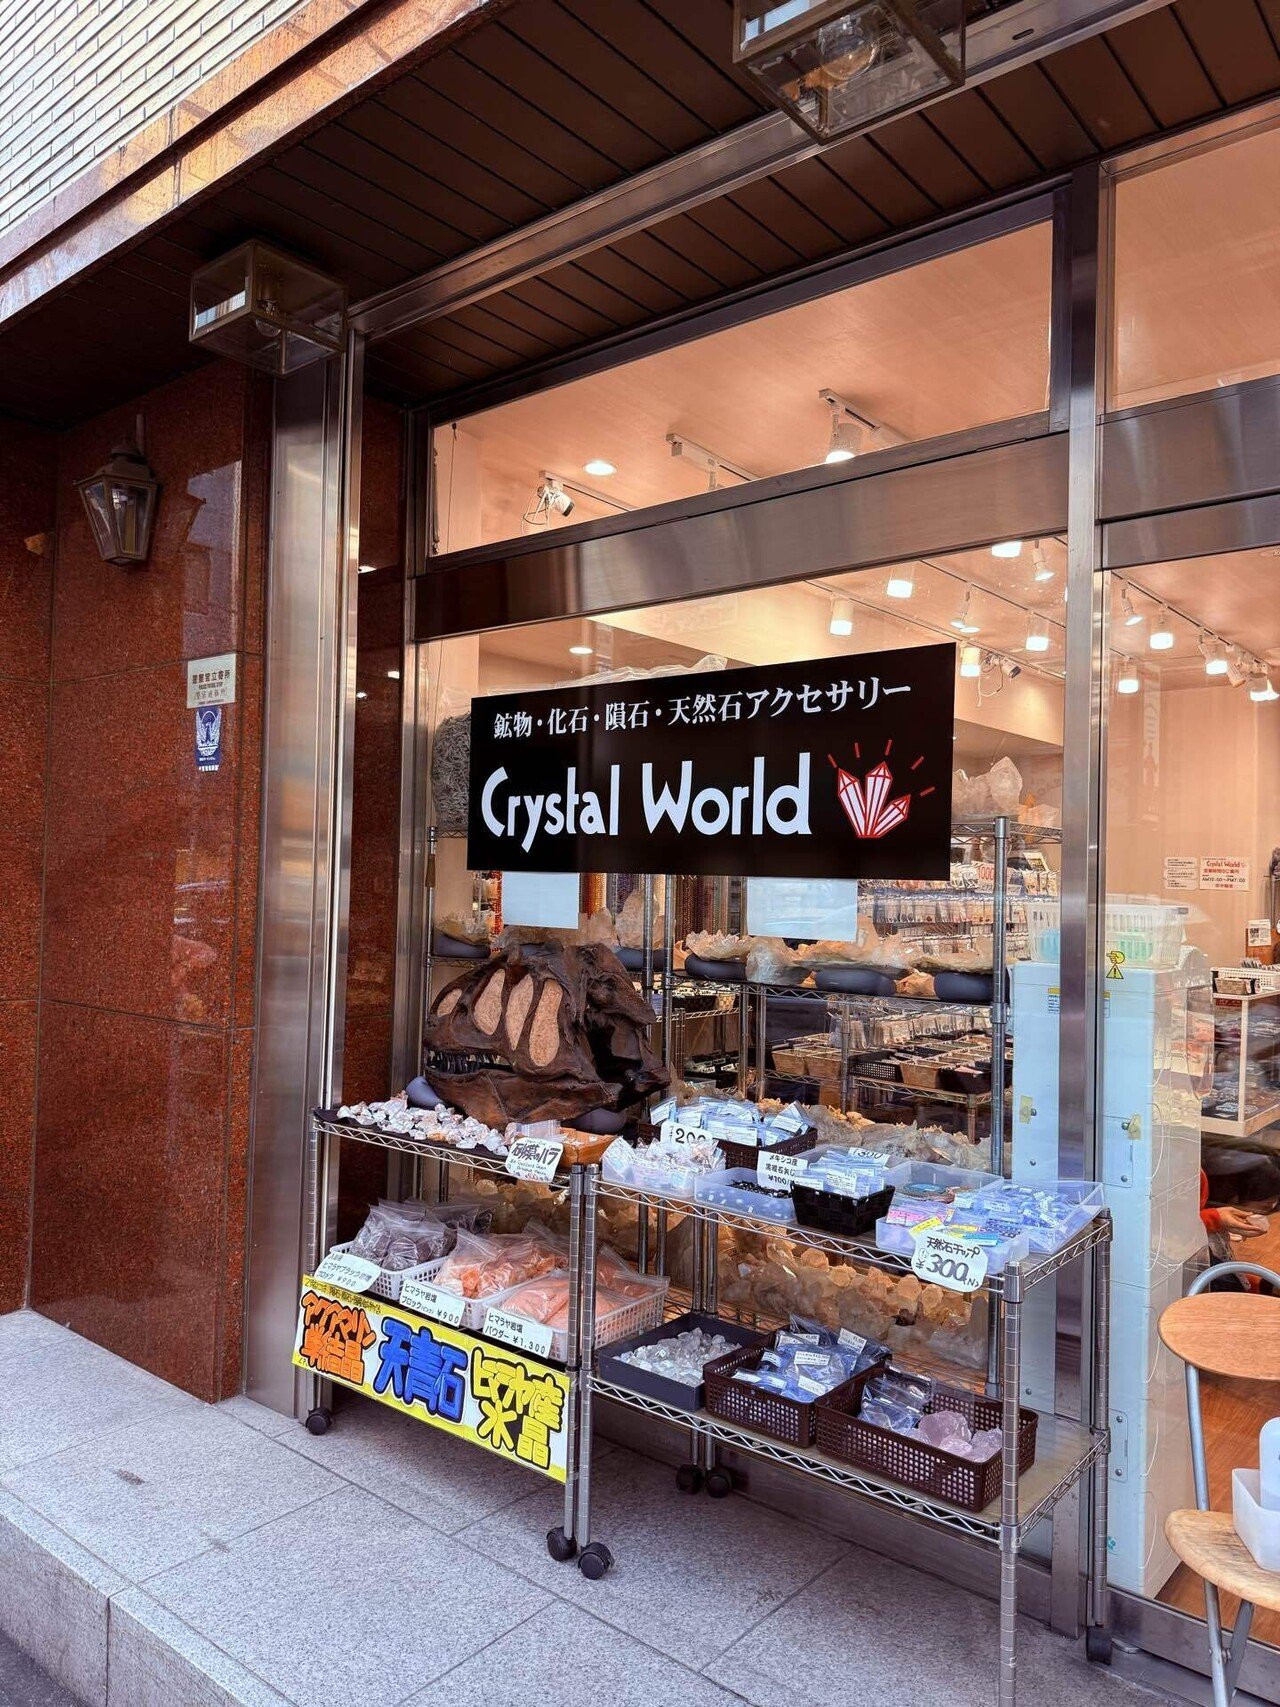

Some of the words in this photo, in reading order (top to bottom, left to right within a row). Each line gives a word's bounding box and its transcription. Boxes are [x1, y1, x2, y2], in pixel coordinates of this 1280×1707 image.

[493, 676, 912, 739] 鉱物・化石・隕石・天然石アクセサリー
[481, 764, 620, 853] Crystal
[642, 752, 812, 836] World
[926, 1236, 981, 1259] 天然石チップ
[404, 1283, 438, 1303] ヒマラヤ岩塩
[437, 1309, 460, 1324] ¥900
[488, 1312, 523, 1333] ヒマラヤ岩塩
[484, 1325, 510, 1340] パウダー
[513, 1336, 546, 1355] ¥1,300
[373, 1316, 468, 1423] 天青石
[477, 1400, 551, 1470] 水晶
